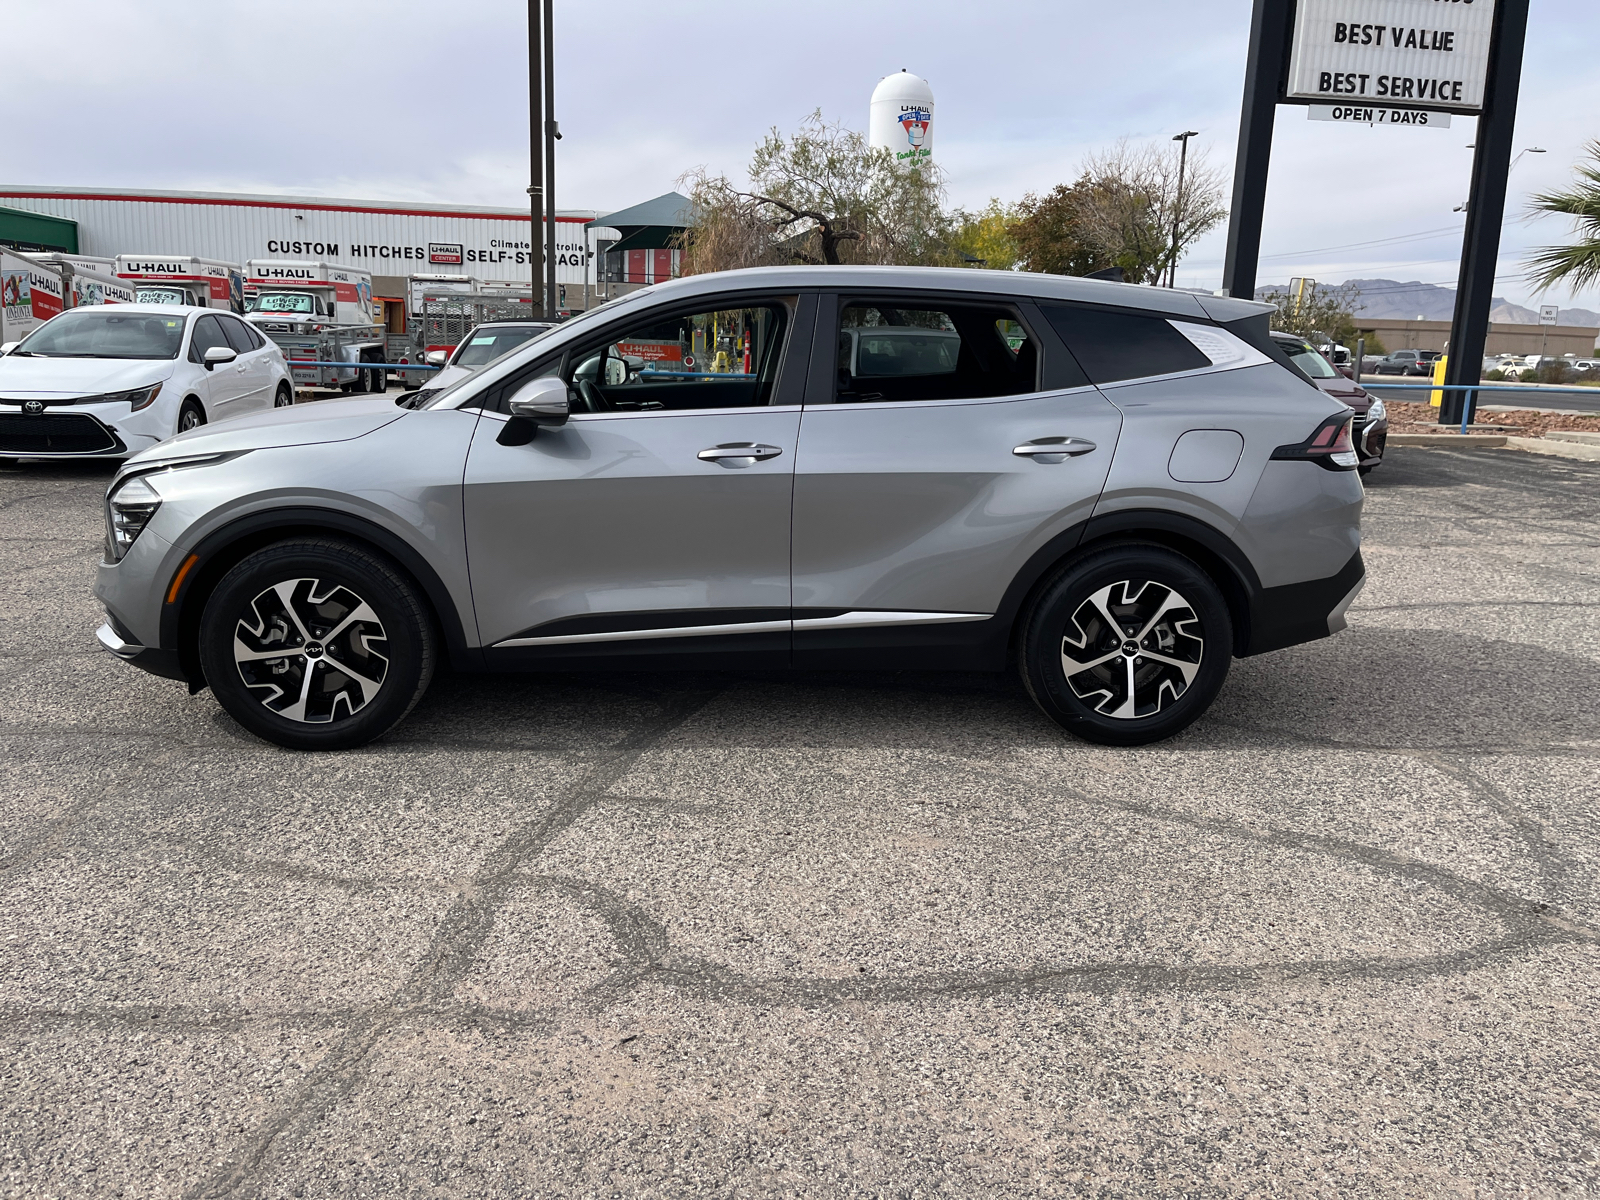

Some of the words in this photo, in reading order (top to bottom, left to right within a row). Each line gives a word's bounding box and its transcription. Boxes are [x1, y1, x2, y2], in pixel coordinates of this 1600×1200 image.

[1334, 22, 1386, 46] BEST
[1391, 27, 1455, 52] VALUE
[1318, 71, 1370, 95] BEST
[1376, 75, 1463, 101] SERVICE
[1332, 107, 1373, 121] OPEN
[1378, 110, 1387, 122] 7
[1390, 111, 1428, 125] DAYS
[267, 240, 339, 256] CUSTOM
[351, 245, 425, 259] HITCHES
[431, 246, 460, 254] U-HAUL
[490, 239, 530, 249] Climate
[127, 262, 186, 273] U-HAUL
[257, 268, 314, 279] U-HAUL
[29, 272, 61, 295] U-HAUL
[104, 285, 133, 302] U-HAUL
[624, 345, 663, 353] U-HAUL
